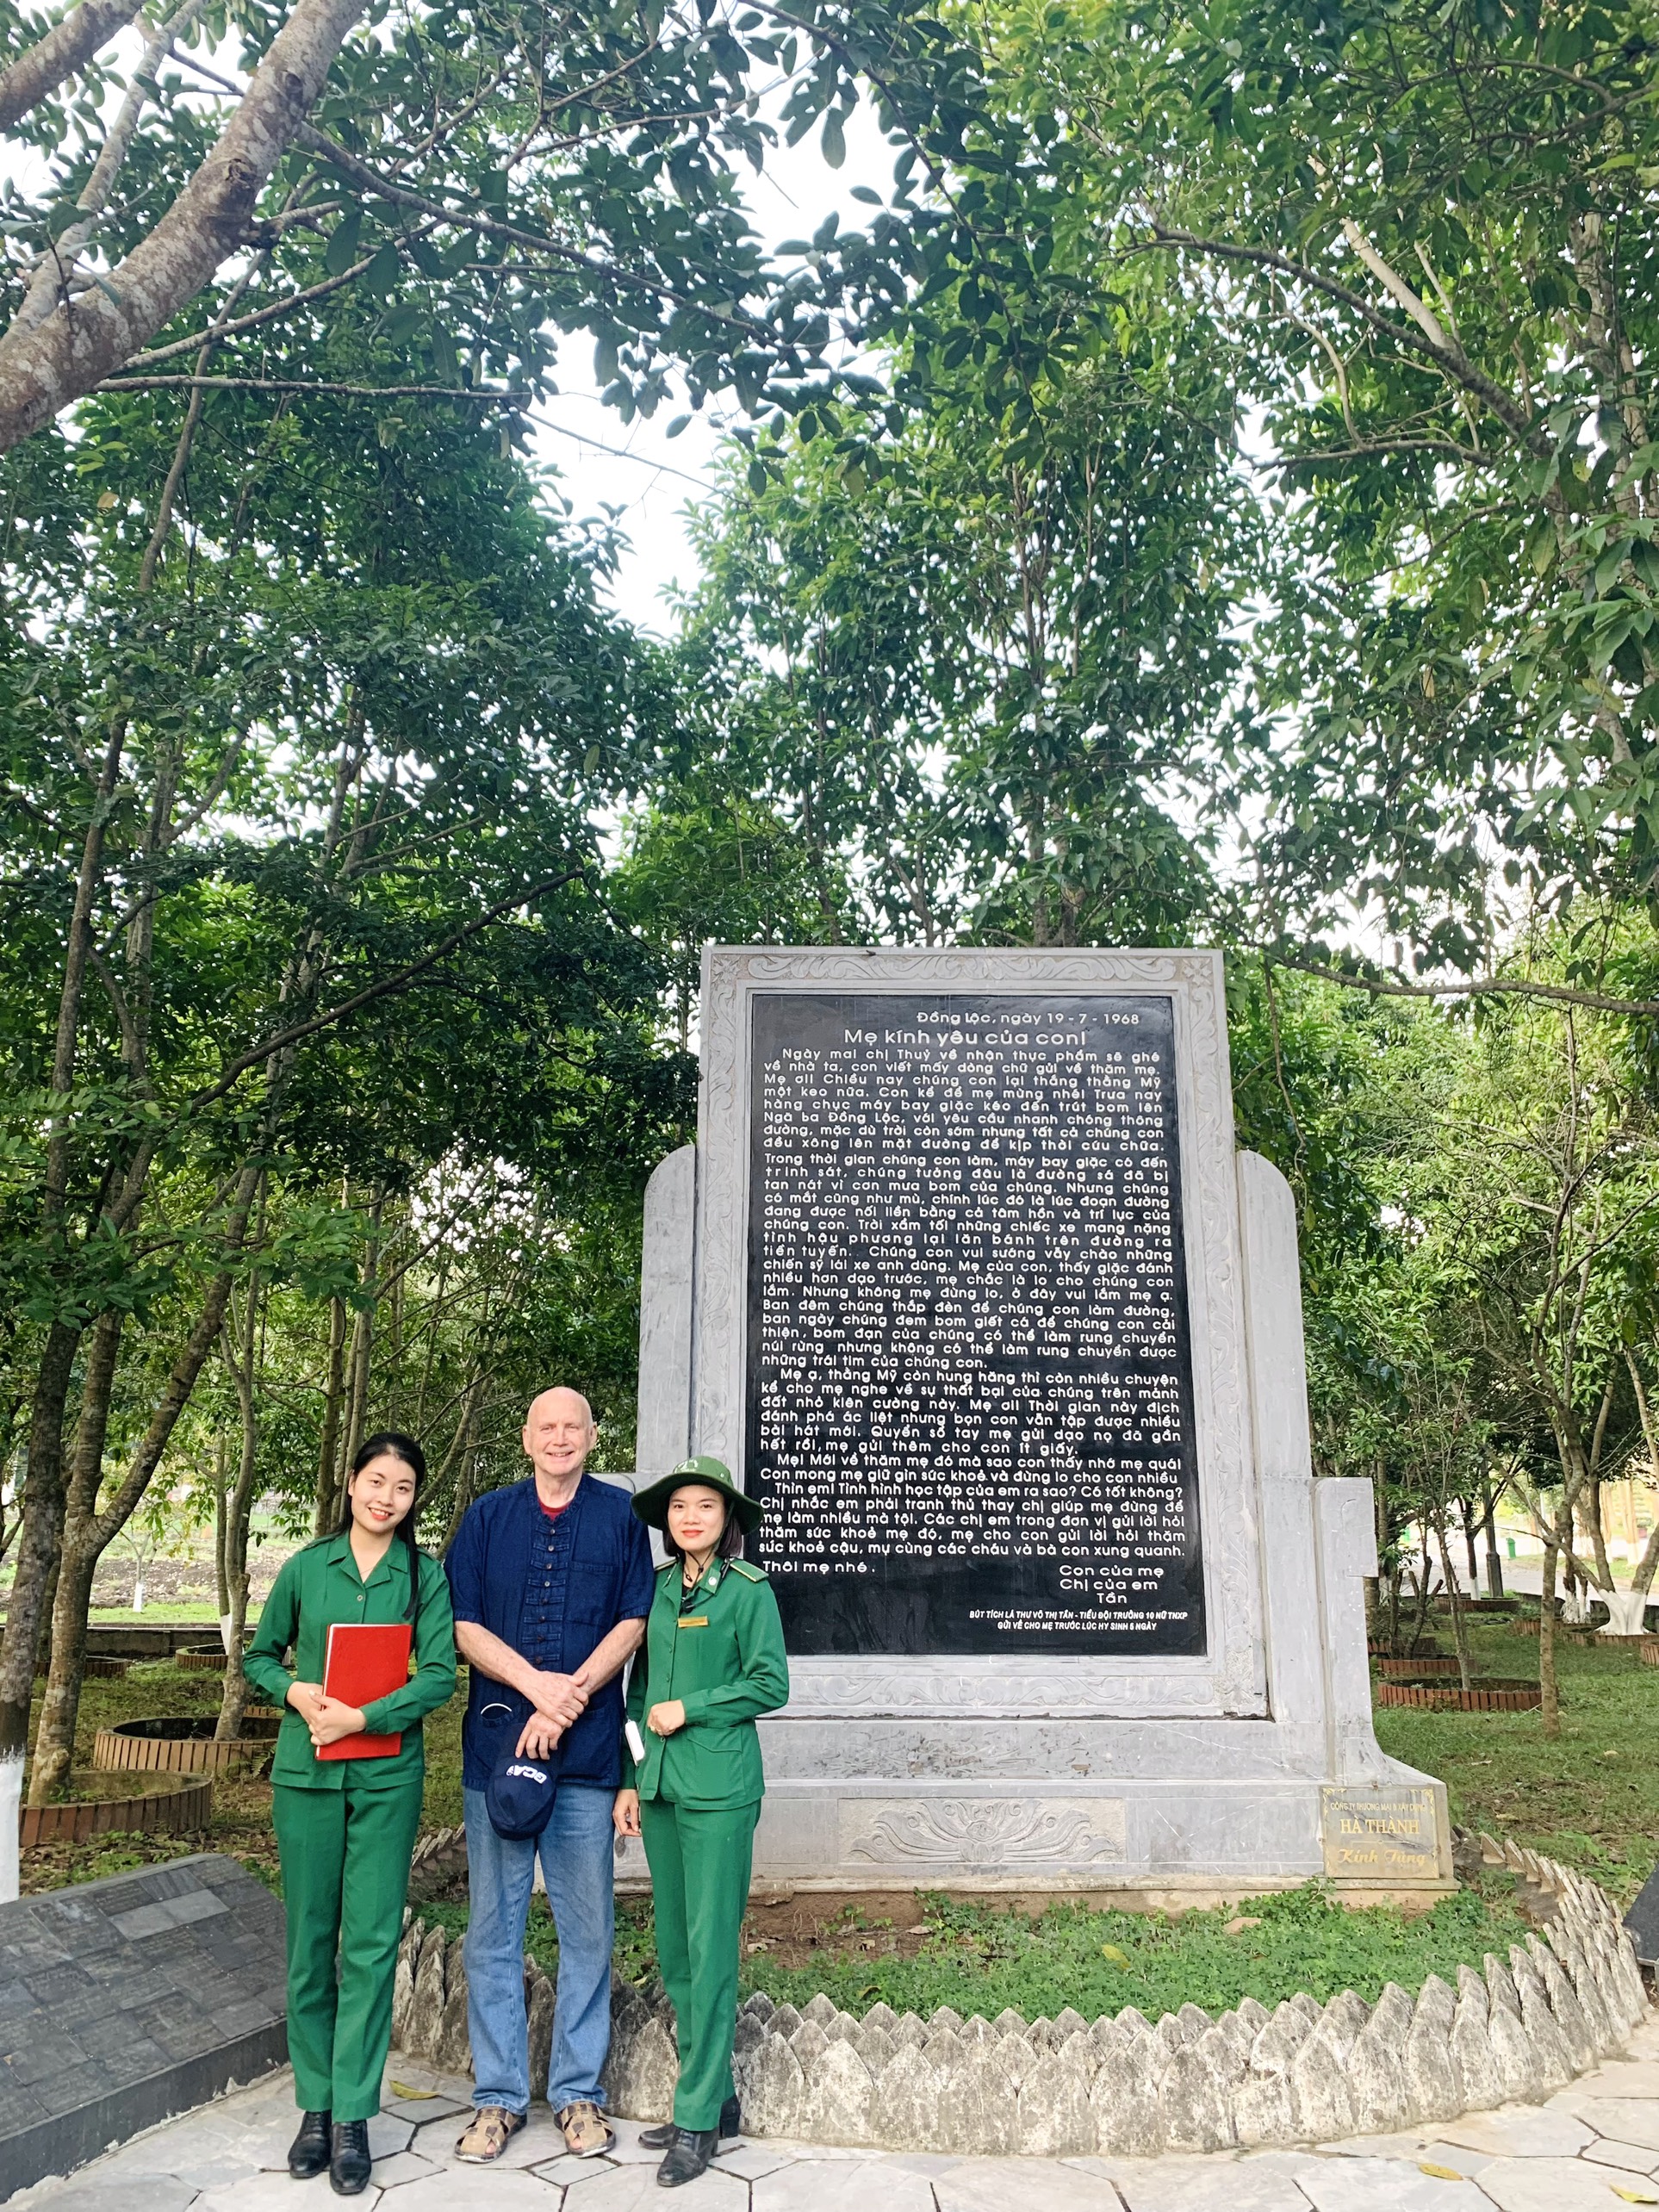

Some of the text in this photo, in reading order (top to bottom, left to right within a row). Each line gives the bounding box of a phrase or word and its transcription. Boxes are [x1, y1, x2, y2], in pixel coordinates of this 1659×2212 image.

[916, 1011, 960, 1024] Đồng
[965, 1012, 996, 1025] Lộc,
[1000, 1011, 1041, 1025] ngày
[1047, 1013, 1064, 1023] 19
[1078, 1013, 1087, 1024] 7
[1103, 1014, 1139, 1024] 1968
[844, 1029, 877, 1046] Mẹ
[885, 1029, 929, 1044] kính
[936, 1030, 977, 1047] yêu
[985, 1029, 1028, 1044] của
[783, 1047, 820, 1060] Ngày
[830, 1048, 855, 1059] mai
[866, 1048, 887, 1060] chị
[939, 1048, 957, 1059] về
[966, 1049, 1003, 1062] nhận
[1012, 1050, 1046, 1062] thực
[1056, 1048, 1097, 1063] phẩm
[1106, 1052, 1122, 1061] sẽ
[1132, 1051, 1159, 1064] ghé
[764, 1110, 1162, 1128] Ngã ba Đồng Lộc, với yêu cầu nhanh chóng thông
[763, 1135, 1163, 1152] đều xông lên mặt đường để kịp thời cứu chữa.
[764, 1178, 1168, 1196] tan nát vì cơn mưa bom của chúng. Nhưng chúng
[764, 1218, 808, 1231] chúng
[818, 1221, 848, 1229] con.
[858, 1218, 882, 1229] Trời
[929, 1218, 948, 1230] tối
[957, 1221, 1001, 1233] những
[1010, 1220, 1049, 1232] chiếc
[1059, 1223, 1075, 1233] xe
[1084, 1224, 1124, 1235] mang
[1134, 1222, 1170, 1235] nặng
[763, 1271, 1172, 1289] nhiều hơn dạo trước, mẹ chắc là lo cho chúng con
[763, 1299, 1174, 1318] Ban đêm chúng thắp đèn để chúng con làm đường,
[761, 1409, 1179, 1428] đánh phá ác liệt nhưng bọn con vẫn tập được nhiều
[811, 1453, 835, 1465] Mới
[841, 1451, 858, 1465] về
[864, 1454, 900, 1465] thăm
[907, 1457, 928, 1469] mẹ
[934, 1455, 953, 1466] đó
[959, 1455, 980, 1467] mà
[986, 1457, 1011, 1467] sao
[1017, 1458, 1044, 1468] con
[1050, 1455, 1082, 1470] thấy
[1089, 1457, 1115, 1469] nhớ
[1121, 1460, 1142, 1471] mẹ
[761, 1561, 874, 1574] Thôi mẹ nhé.
[1059, 1564, 1164, 1578] Con của mẹ
[1059, 1578, 1157, 1591] Chị của em
[1097, 1591, 1126, 1603] Tần
[969, 1609, 985, 1618] BÚT
[986, 1609, 1003, 1618] TÍCH
[1097, 1610, 1111, 1620] ĐỘI
[1041, 1621, 1053, 1631] MẸ
[1054, 1619, 1080, 1629] TRƯỚC
[1081, 1621, 1097, 1630] LÚC
[1097, 1619, 1109, 1630] HY
[1134, 1621, 1157, 1630] NGÀY
[1340, 1815, 1420, 1834] HÀ THÀNH
[1338, 1849, 1378, 1863] Kính
